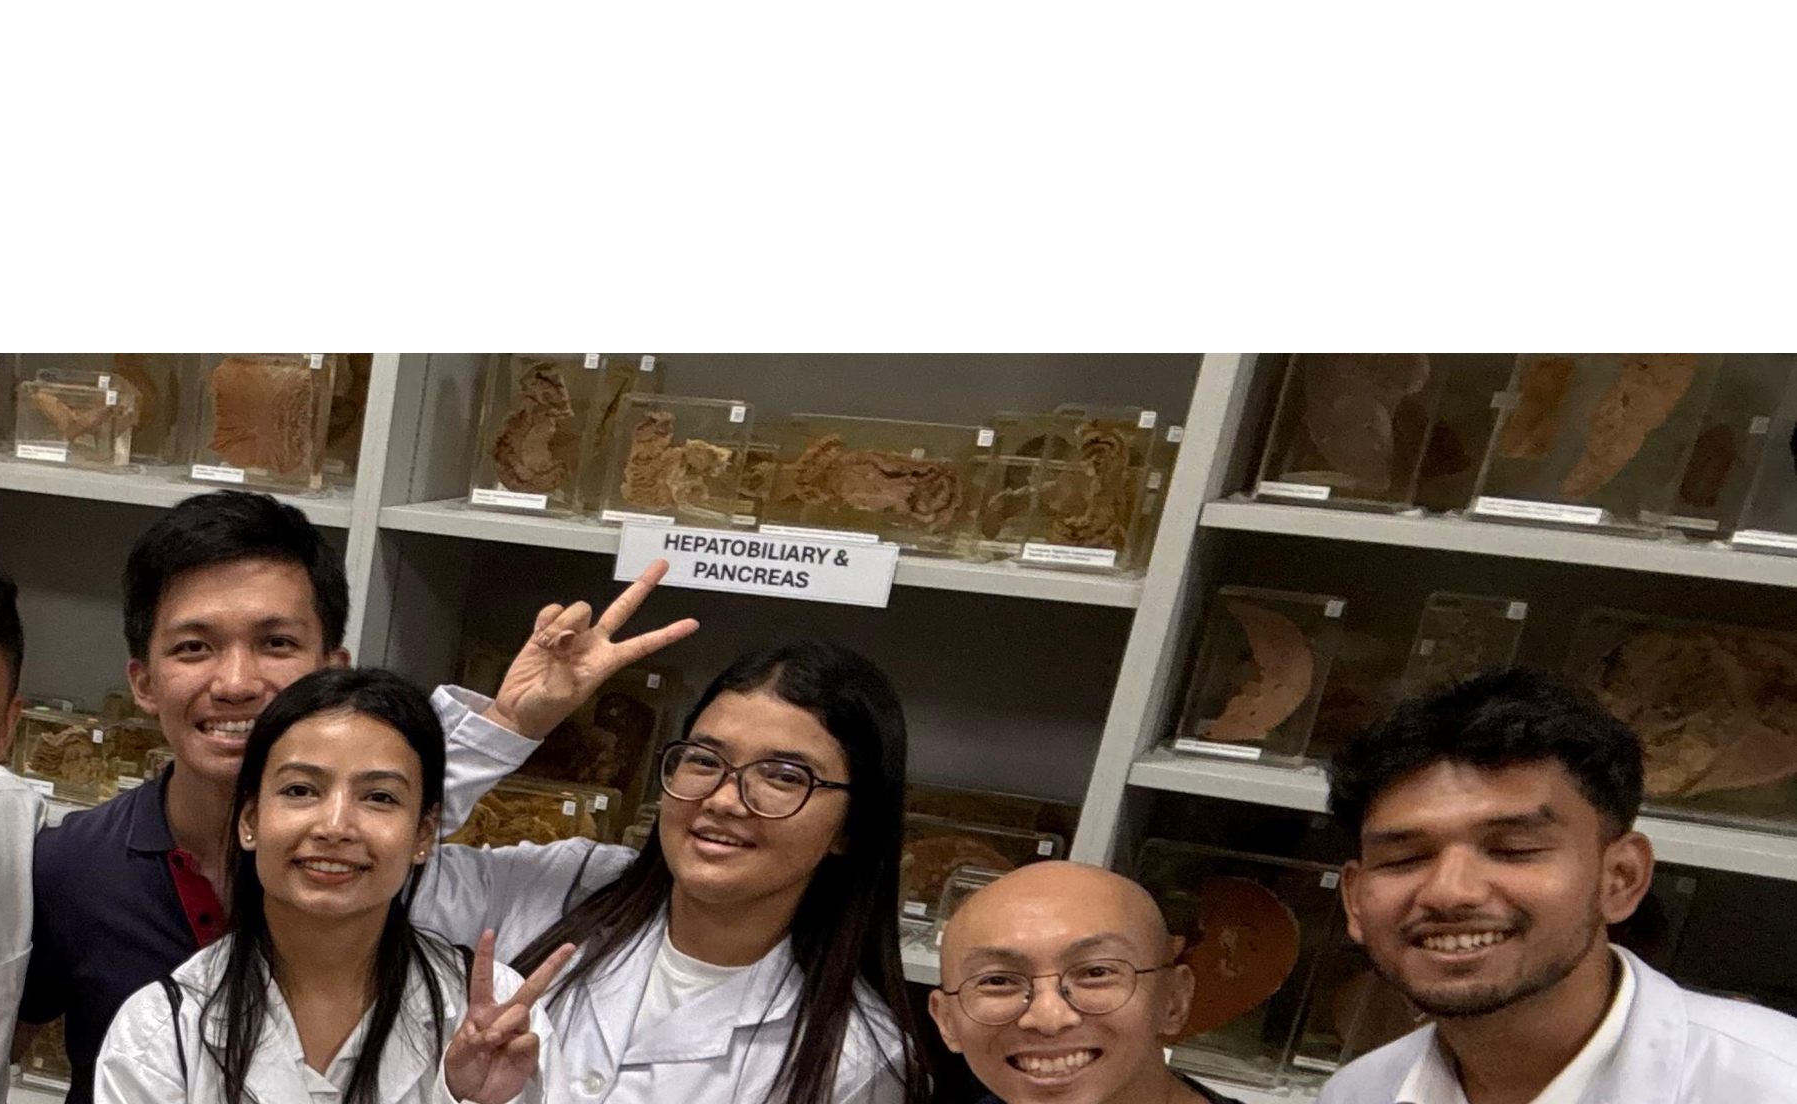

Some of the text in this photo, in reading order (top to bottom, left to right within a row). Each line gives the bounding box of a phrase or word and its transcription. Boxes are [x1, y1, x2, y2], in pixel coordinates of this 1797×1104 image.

[664, 533, 831, 565] HEPATOBILIARY
[833, 549, 850, 567] &
[693, 561, 811, 589] PANCREAS
